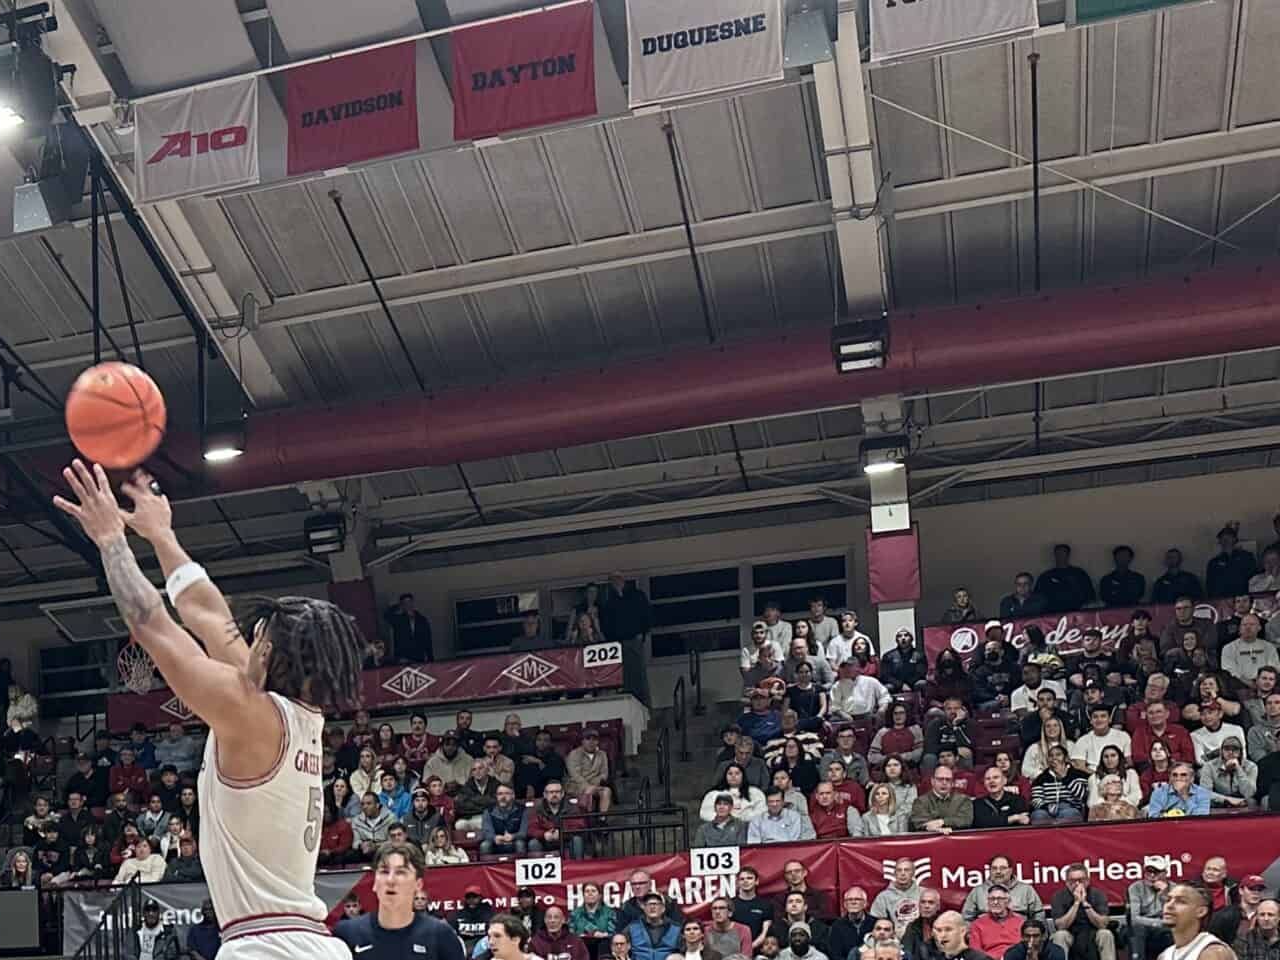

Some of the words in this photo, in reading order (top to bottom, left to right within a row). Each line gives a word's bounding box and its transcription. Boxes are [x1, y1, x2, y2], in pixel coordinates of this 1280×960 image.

[641, 13, 767, 56] DUQUESNE
[471, 53, 577, 93] DAYTON
[300, 90, 404, 129] DAVIDSON
[587, 647, 620, 663] 202
[303, 786, 321, 853] 5
[522, 863, 557, 881] 102
[696, 853, 734, 870] 103
[667, 875, 737, 905] AREN
[941, 863, 991, 889] Mai
[427, 896, 520, 912] WELME
